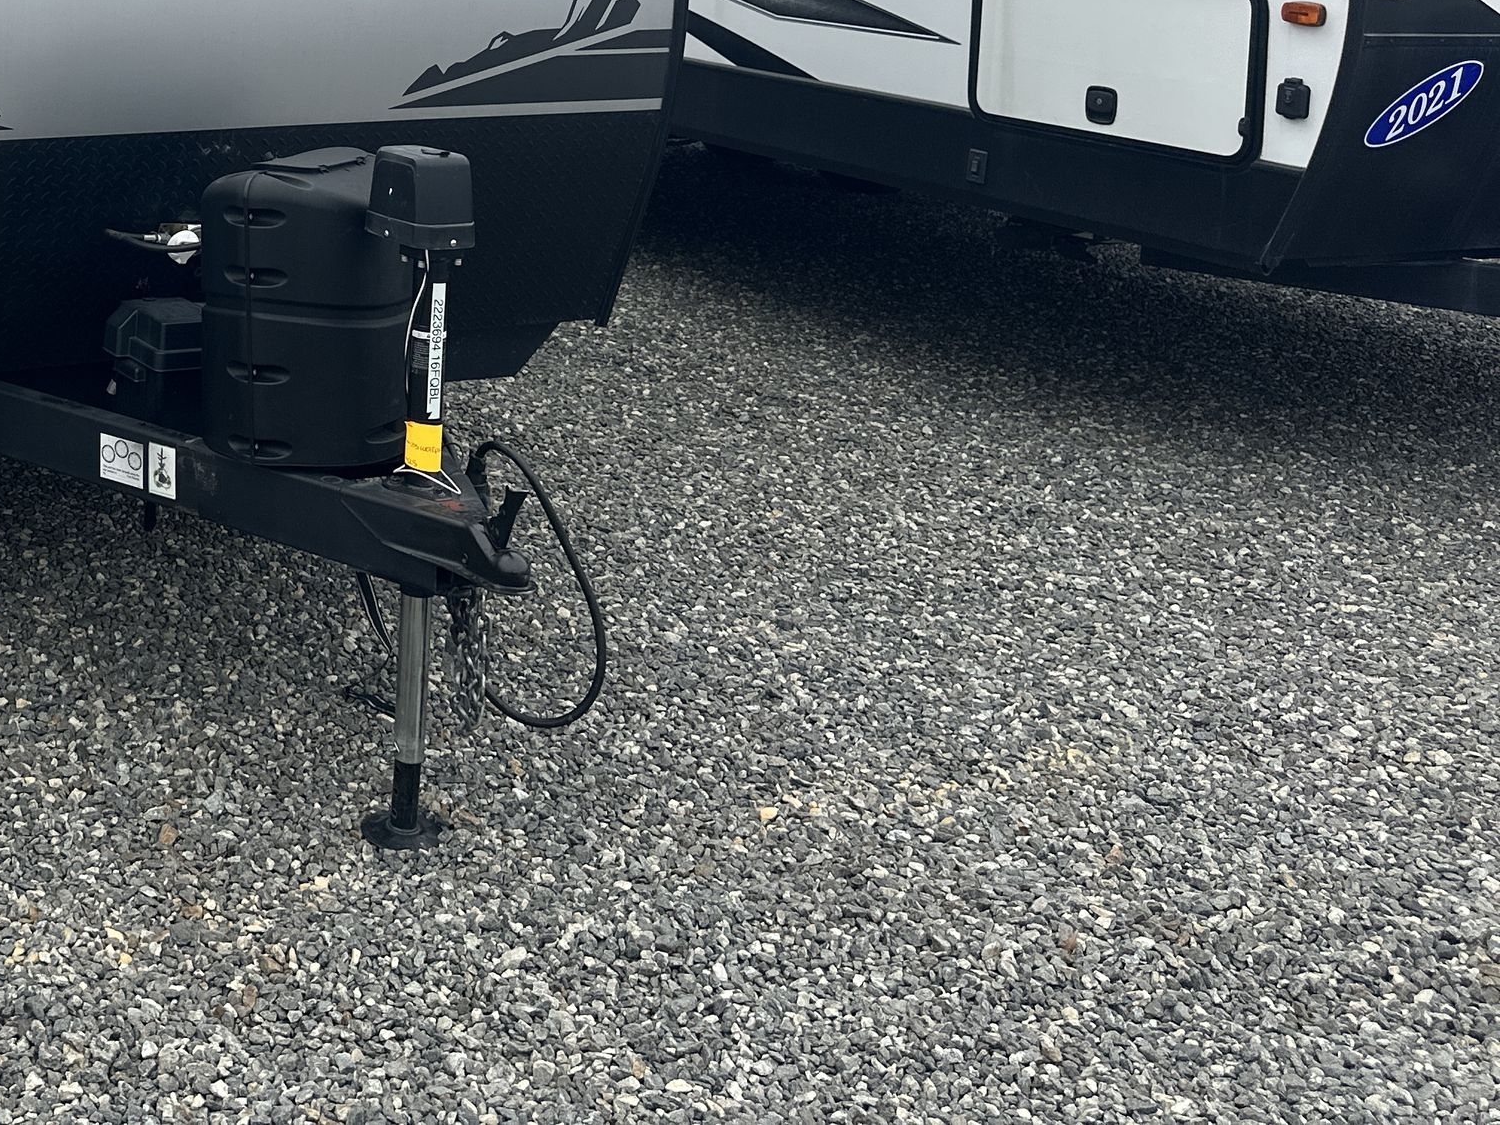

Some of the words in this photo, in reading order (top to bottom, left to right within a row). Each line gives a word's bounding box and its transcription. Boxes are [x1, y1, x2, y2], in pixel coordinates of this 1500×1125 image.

[1385, 66, 1464, 142] 2021
[431, 299, 445, 351] 2223694
[429, 356, 442, 405] 16FQBL
